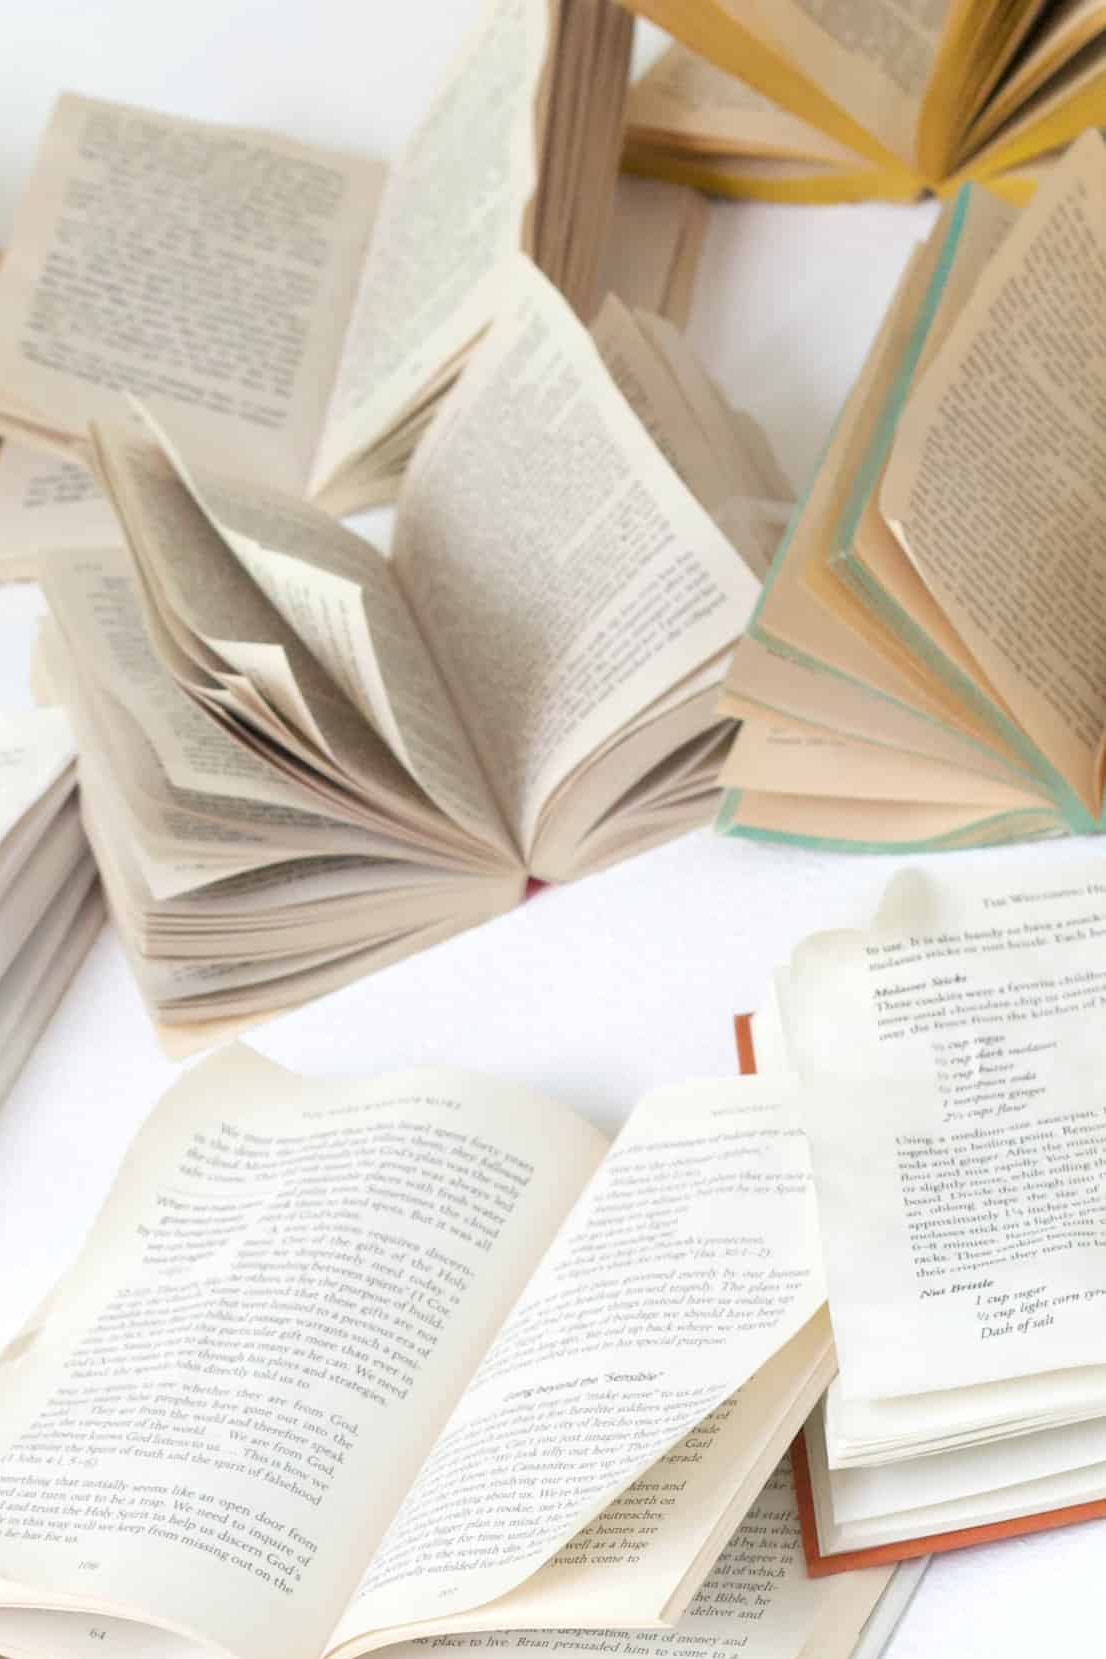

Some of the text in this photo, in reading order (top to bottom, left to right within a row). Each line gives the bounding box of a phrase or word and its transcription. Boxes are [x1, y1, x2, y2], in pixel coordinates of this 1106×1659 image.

[987, 1294, 1009, 1306] cup
[1014, 1285, 1046, 1300] sugar
[993, 1308, 1015, 1319] cup
[1020, 1300, 1049, 1315] light
[1052, 1293, 1079, 1306] corn
[980, 1314, 1054, 1339] Dash of salt
[172, 1485, 318, 1553] like an open door from
[174, 1500, 313, 1567] We need to inquire of
[596, 1526, 634, 1535] homes
[590, 1556, 624, 1565] come
[631, 1555, 640, 1564] to
[738, 1609, 764, 1620] and
[433, 1637, 464, 1650] place
[470, 1639, 483, 1647] to
[517, 1639, 550, 1648] Brian
[553, 1639, 619, 1654] persuaded
[624, 1644, 650, 1656] him
[655, 1648, 668, 1656] to
[673, 1650, 708, 1659] come
[712, 1650, 726, 1659] to
[730, 1652, 739, 1659] a
[636, 1631, 748, 1648] out of money and
